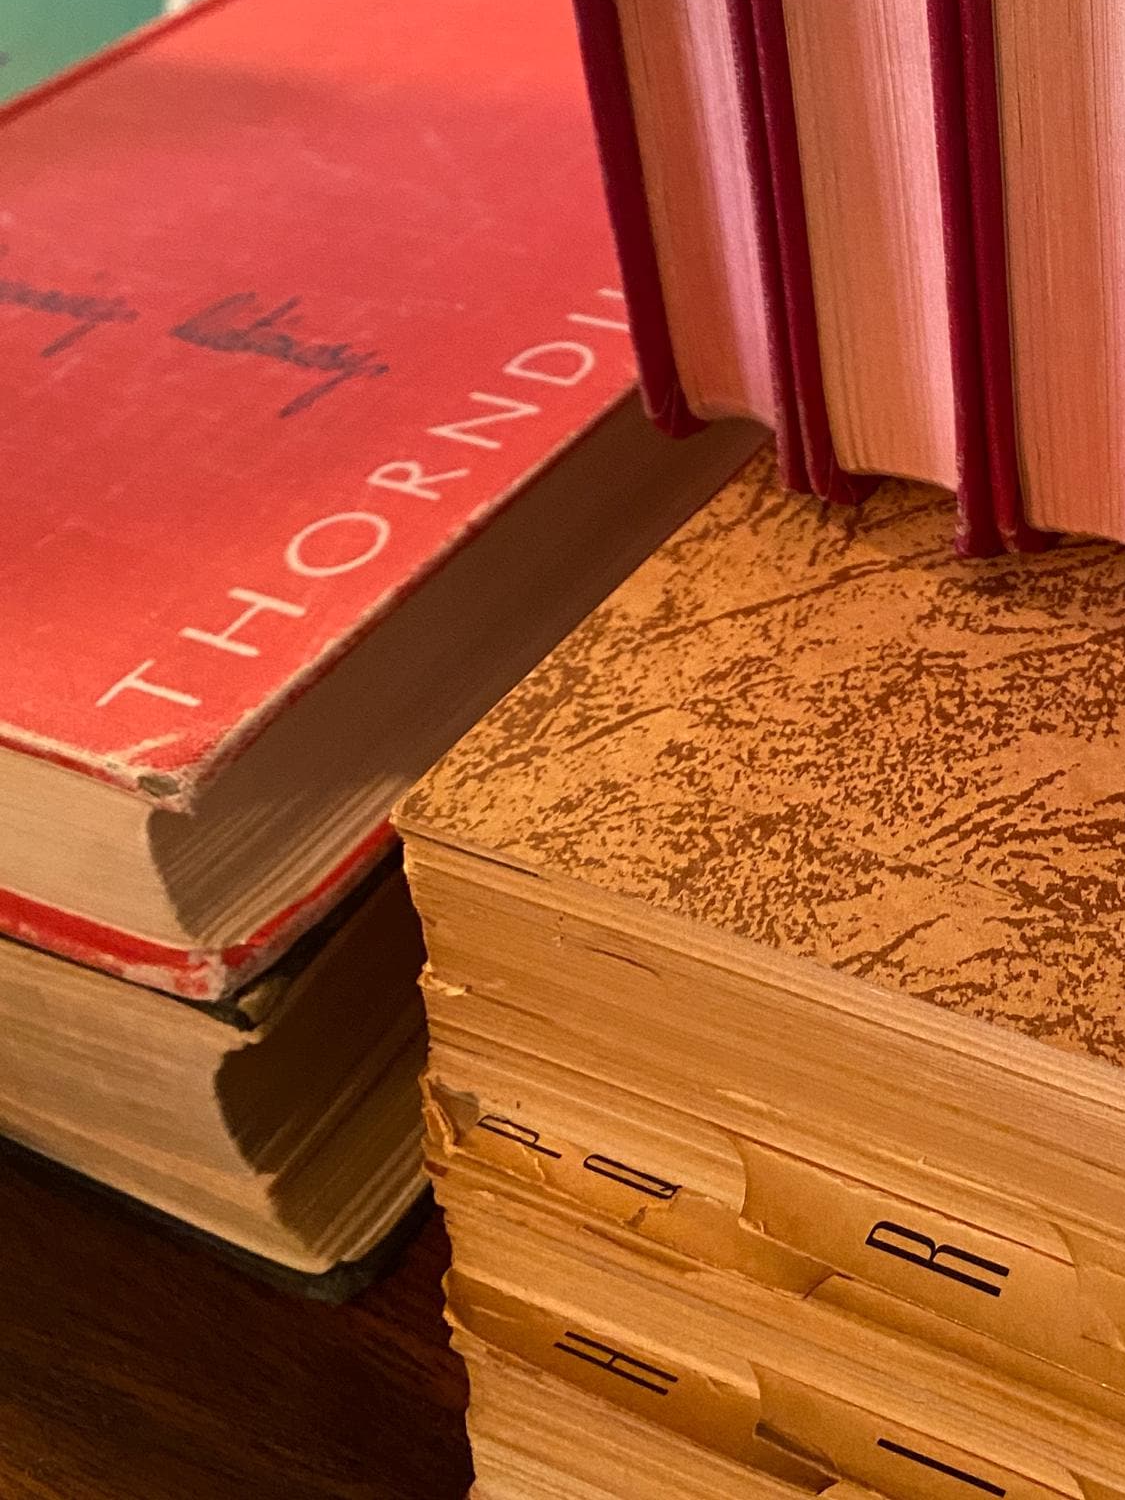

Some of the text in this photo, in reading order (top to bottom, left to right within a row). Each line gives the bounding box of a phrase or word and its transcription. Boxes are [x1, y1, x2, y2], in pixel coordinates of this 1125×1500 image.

[96, 288, 632, 707] THORNDI
[864, 1219, 1010, 1298] R
[553, 1330, 679, 1396] H
